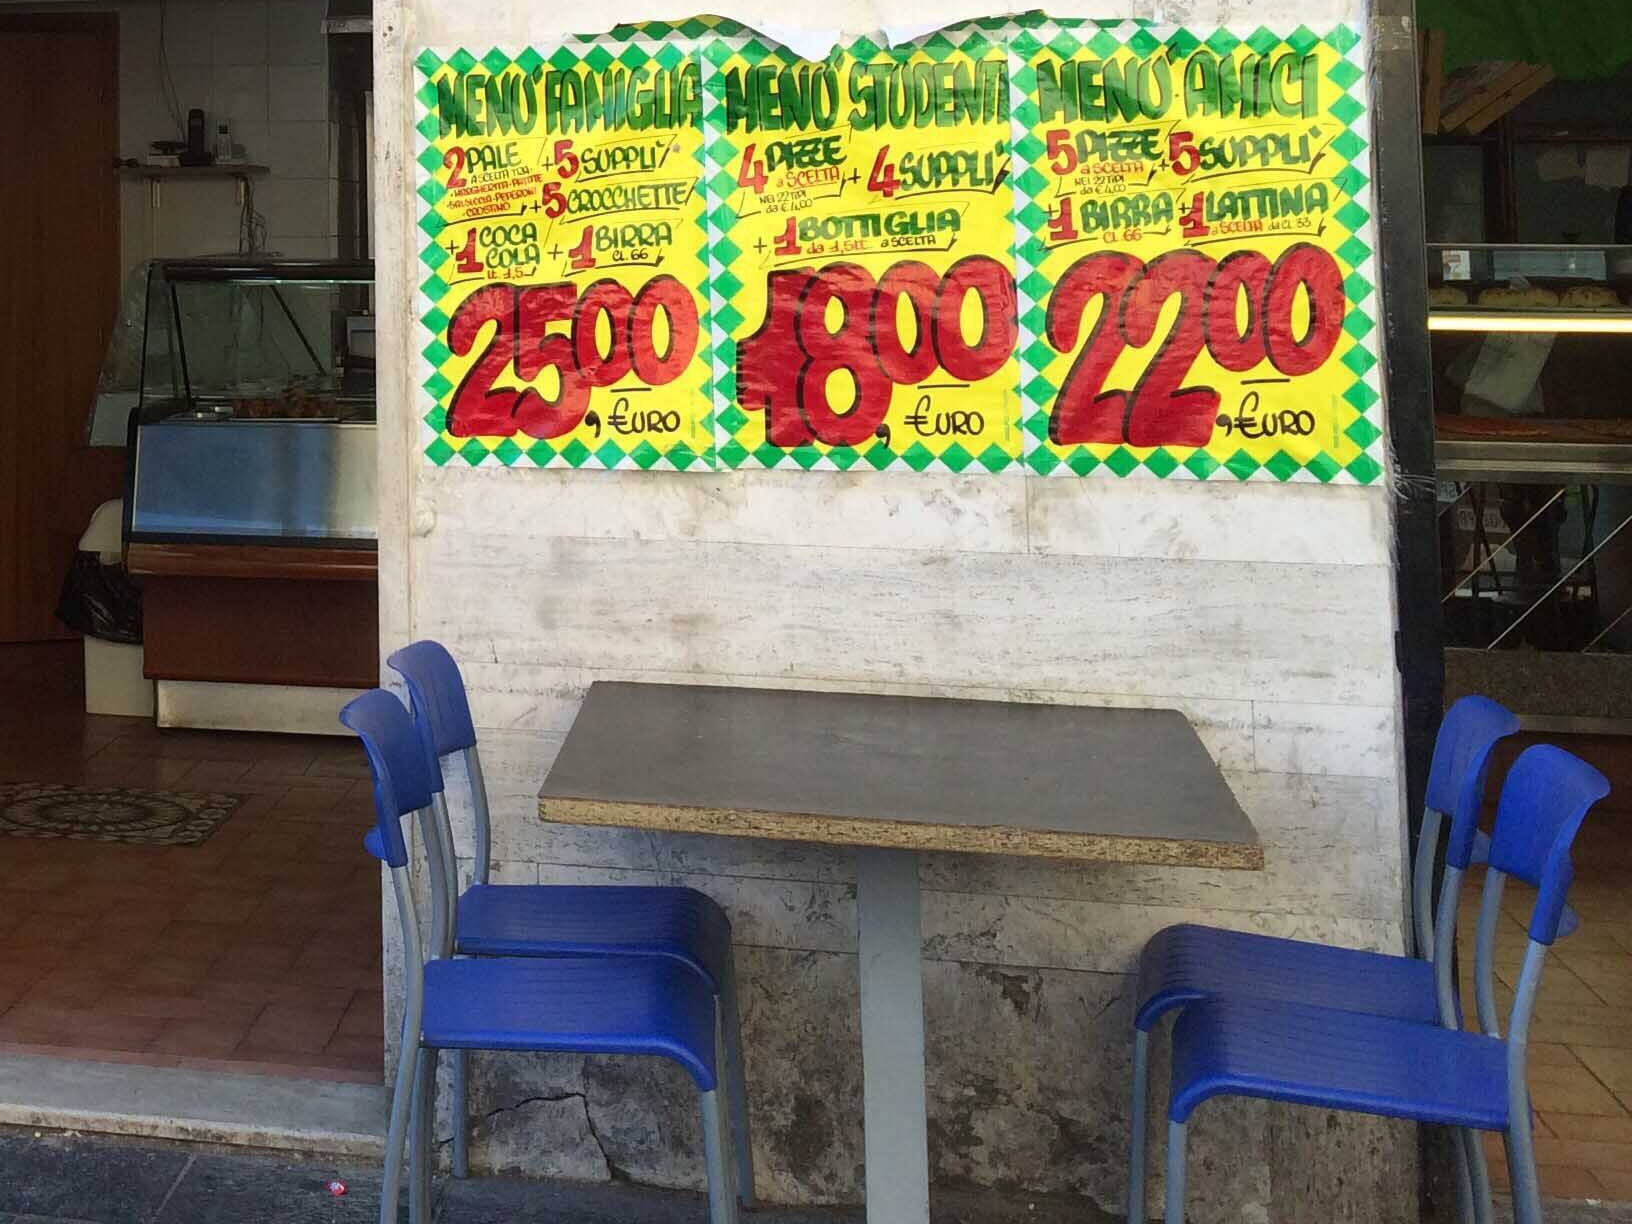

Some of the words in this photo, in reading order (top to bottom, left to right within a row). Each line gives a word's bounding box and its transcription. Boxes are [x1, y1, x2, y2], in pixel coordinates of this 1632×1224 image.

[545, 62, 703, 136] FAMIGLIA
[1183, 49, 1320, 120] AMICI
[465, 142, 522, 174] PALE
[737, 142, 769, 195] 4
[764, 134, 847, 173] PIZZE
[1046, 128, 1078, 176] 5
[1075, 127, 1164, 164] PIZZE
[1091, 160, 1144, 175] SCELTA
[786, 165, 841, 189] SCELTA
[866, 143, 903, 198] 4
[566, 181, 688, 215] CROCCHETTE
[1079, 191, 1174, 234] BIRRA
[1206, 182, 1330, 222] LATTINA
[479, 222, 538, 248] COCA
[594, 221, 673, 252] BIRRA
[798, 208, 962, 242] BOTTIGLIA
[891, 233, 937, 247] SCELTA
[485, 243, 540, 269] COLA
[631, 248, 649, 261] 66
